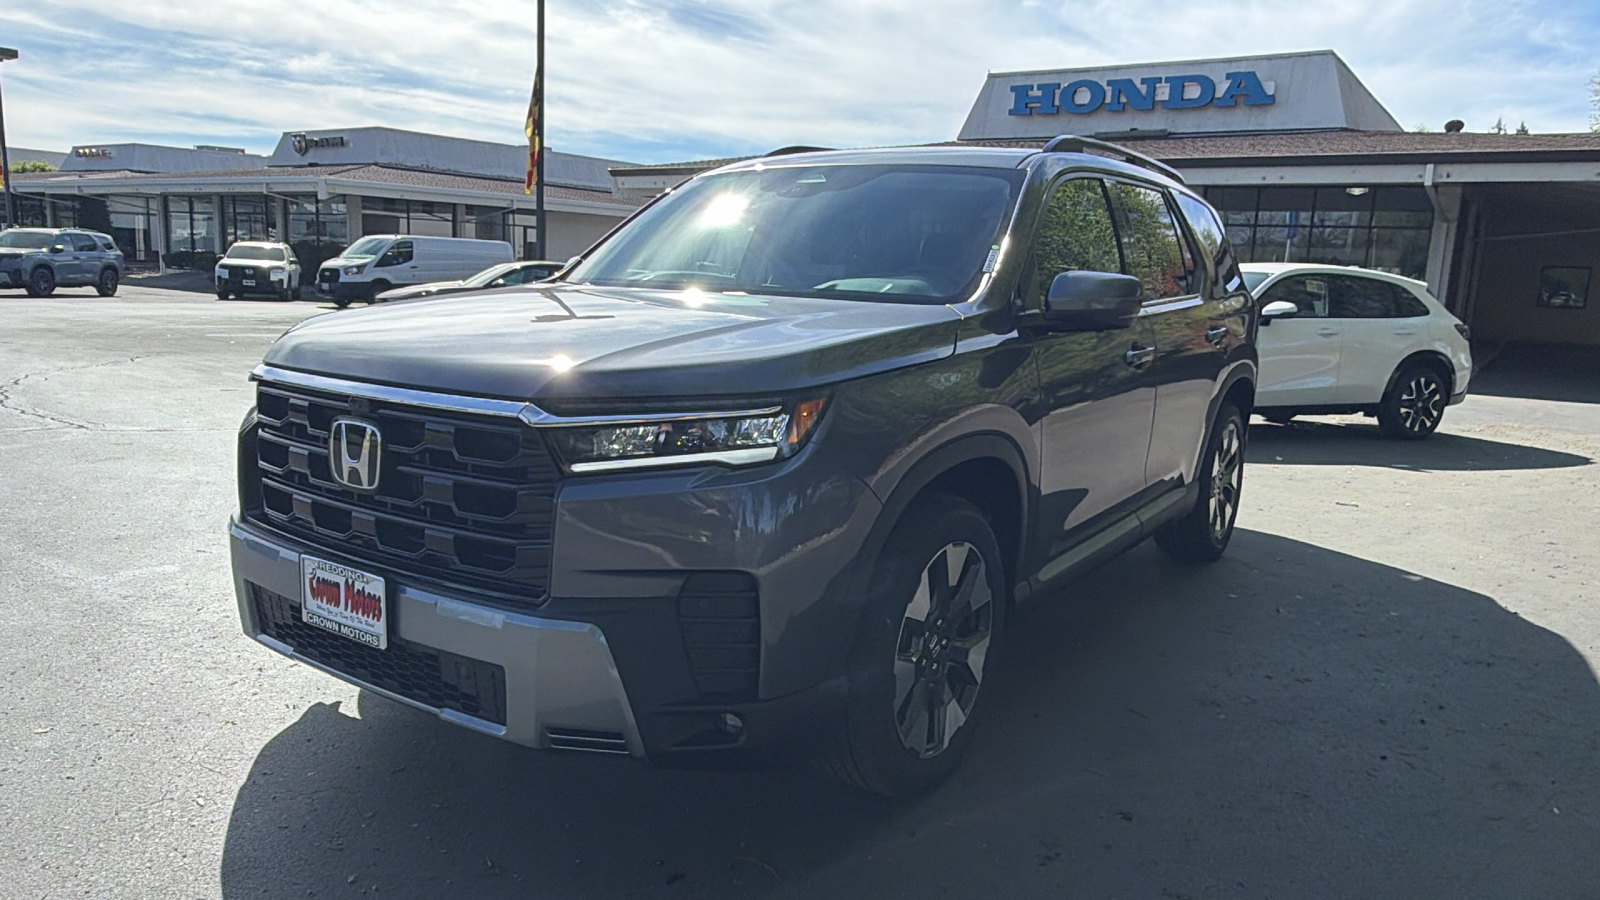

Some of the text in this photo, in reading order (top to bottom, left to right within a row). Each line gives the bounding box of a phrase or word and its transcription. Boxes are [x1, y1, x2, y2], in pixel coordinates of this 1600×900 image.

[1008, 71, 1275, 115] HONDA
[319, 562, 363, 582] REDDING
[344, 577, 382, 622] Motors
[307, 613, 379, 646] CROWN MOTORS
